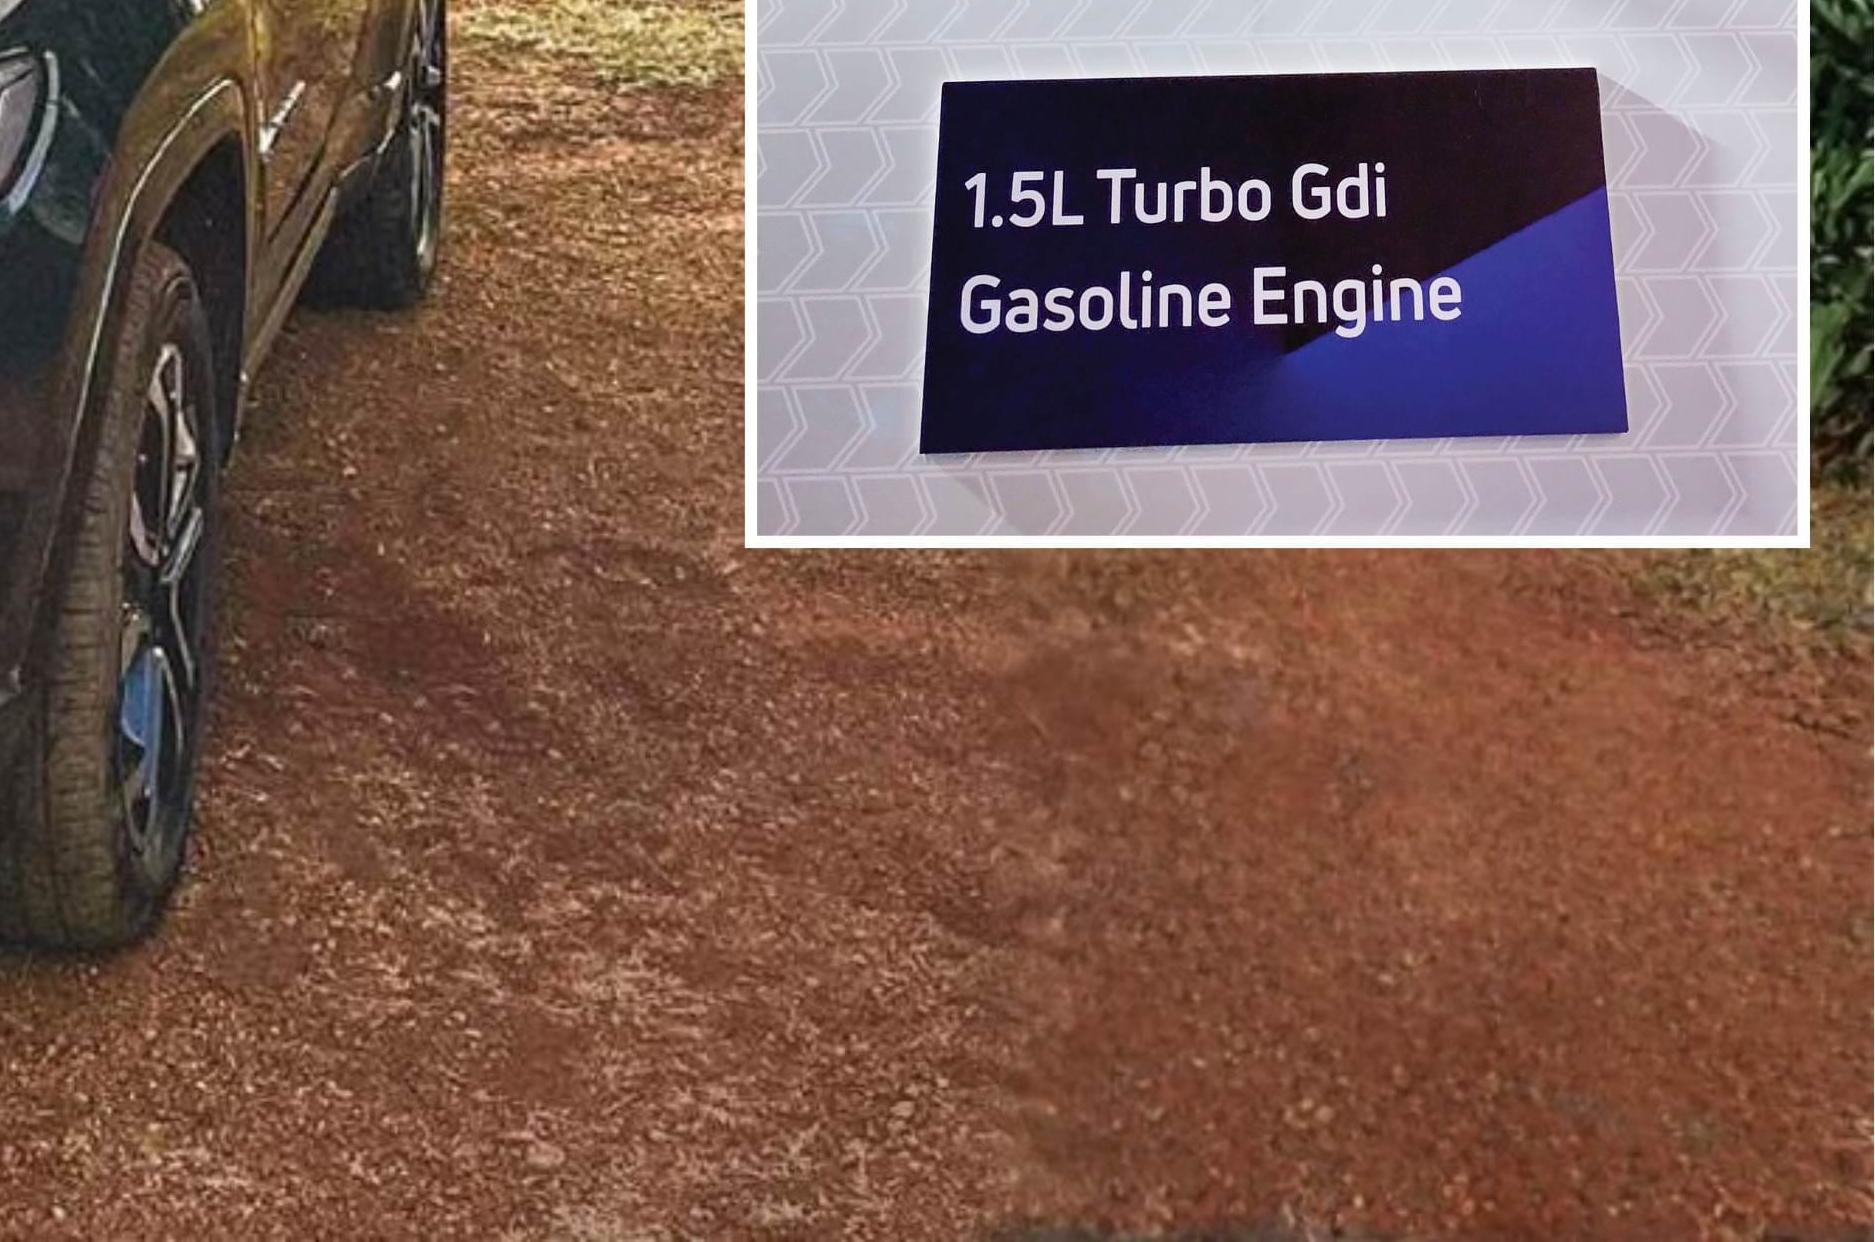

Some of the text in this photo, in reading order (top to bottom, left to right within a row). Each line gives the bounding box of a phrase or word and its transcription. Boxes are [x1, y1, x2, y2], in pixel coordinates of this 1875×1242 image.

[964, 162, 1387, 229] 1.5L Turbo Gdi
[959, 263, 1463, 338] Gasoline Engine
